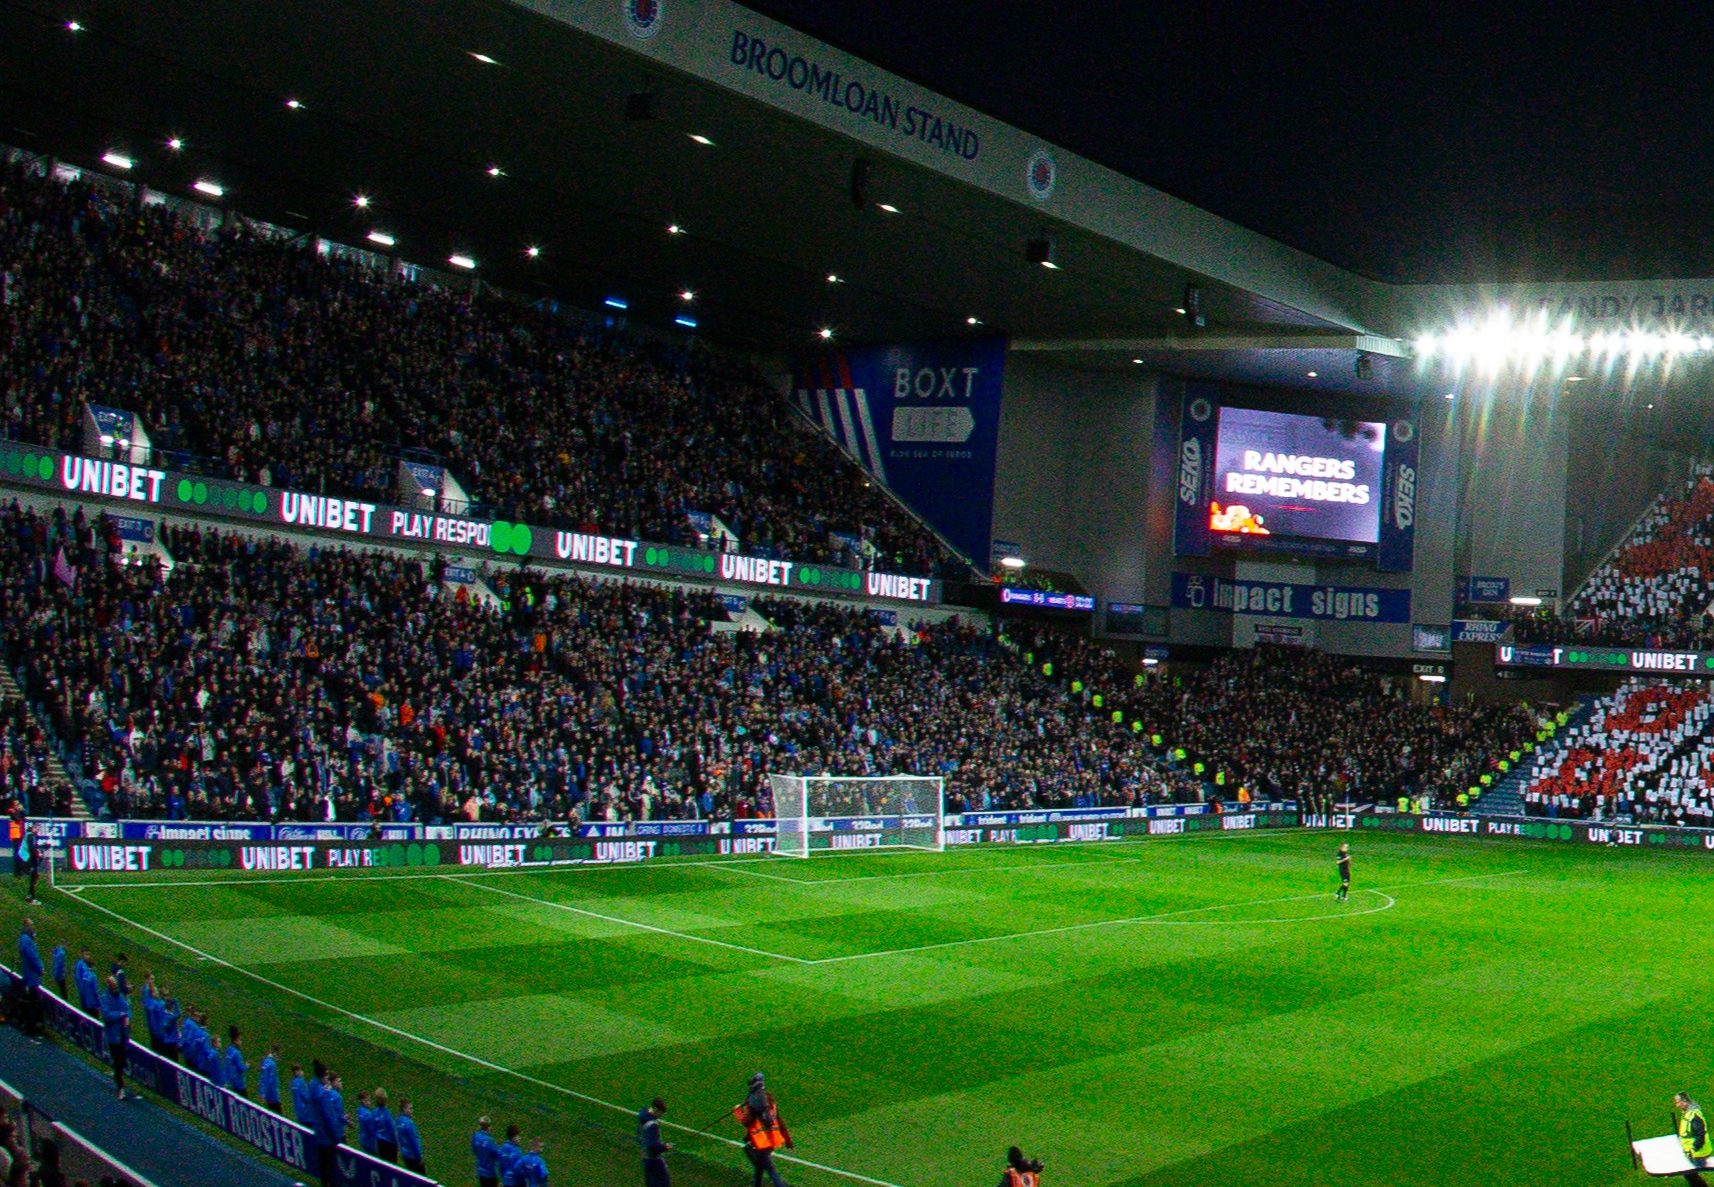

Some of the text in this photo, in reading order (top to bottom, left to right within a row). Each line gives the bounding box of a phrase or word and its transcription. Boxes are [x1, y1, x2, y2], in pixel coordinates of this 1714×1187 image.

[729, 29, 980, 161] BROOMLOAN STAND
[894, 367, 979, 398] BOXT
[1179, 436, 1200, 506] SEKO
[1243, 449, 1356, 480] RANGERS
[62, 455, 166, 502] UNIBET
[1225, 472, 1371, 505] REMEMBERS
[1394, 463, 1417, 530] SEKO
[280, 491, 376, 533] UNIBET
[391, 511, 434, 539] PLAY
[556, 531, 638, 567] UNIBET
[720, 554, 794, 586] UNIBET
[866, 572, 931, 601] UNIBET
[1212, 578, 1380, 620] Impact signs
[1458, 632, 1503, 643] EXPRESS
[1465, 622, 1497, 633] RHINO
[1632, 652, 1698, 671] UNIBET
[1068, 823, 1109, 840] UNIBET
[1148, 819, 1186, 835] UNIBET
[1222, 815, 1256, 830] UNIBET
[1422, 817, 1480, 833] UNIBET
[1488, 822, 1512, 834] PLAY
[718, 837, 776, 855] UNIBET
[832, 833, 882, 850] UNIBET
[941, 829, 983, 845] NIBET
[1588, 828, 1644, 845] UNBET
[72, 845, 151, 871] UNIBET
[241, 846, 315, 870] UNIBET
[327, 848, 365, 867] PLAY
[459, 844, 527, 866] UNIBET
[595, 841, 657, 862] UNIBET
[176, 1069, 307, 1170] BLACK ROOSTER
